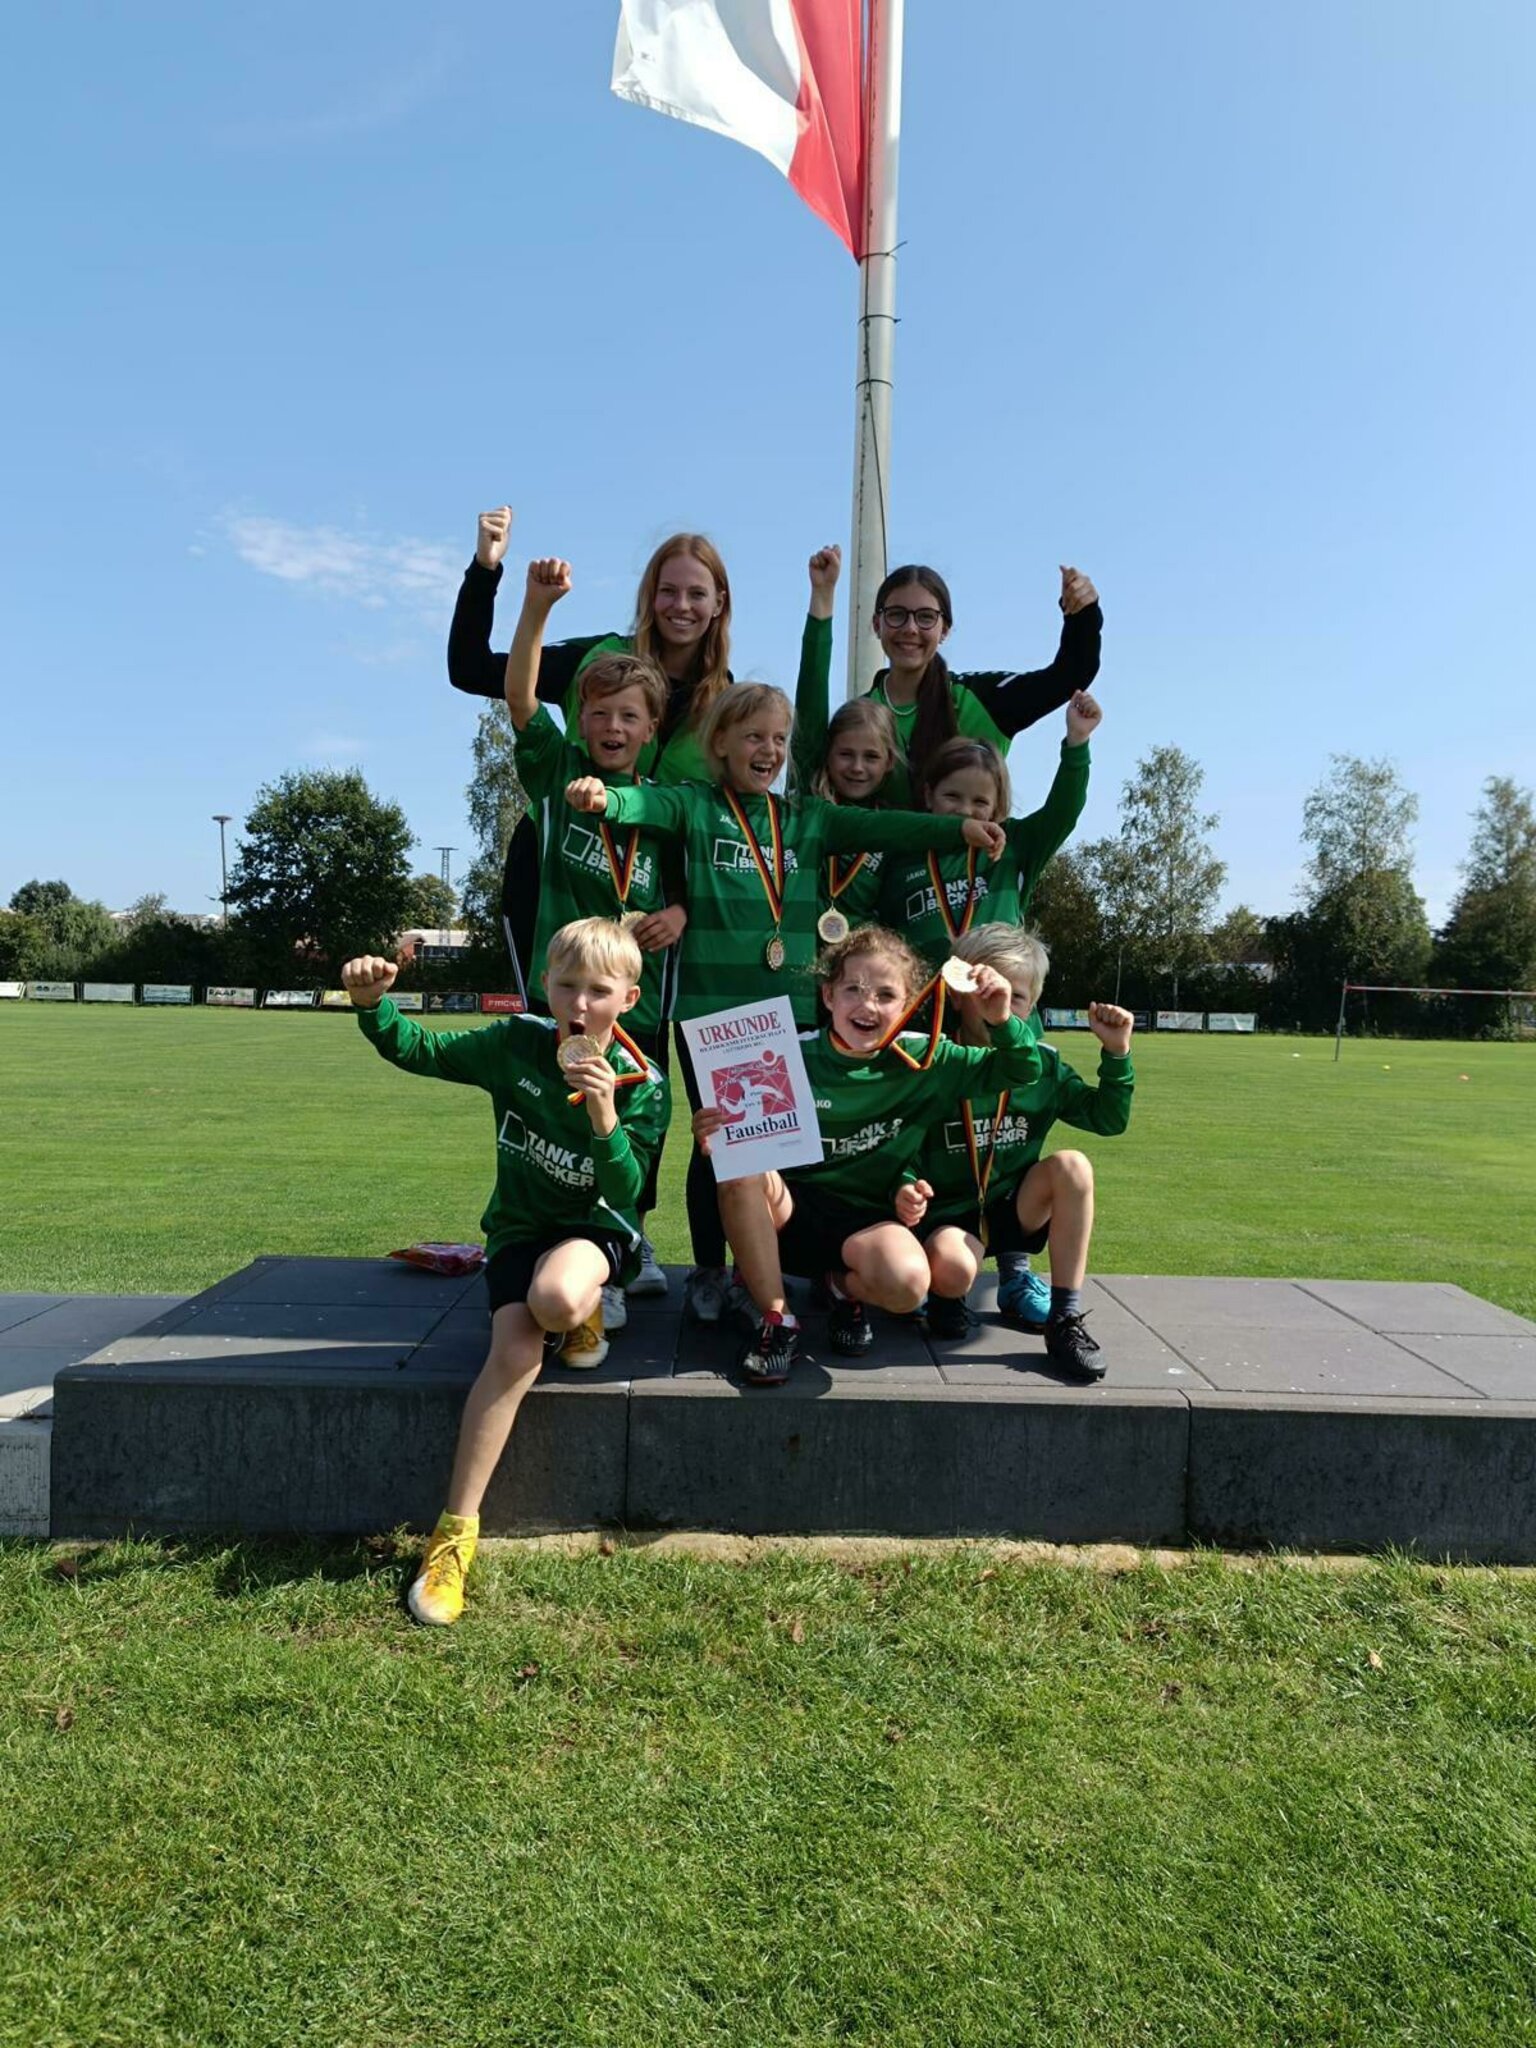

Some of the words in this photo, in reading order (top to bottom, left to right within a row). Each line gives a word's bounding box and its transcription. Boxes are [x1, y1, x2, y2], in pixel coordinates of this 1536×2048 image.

[698, 1010, 782, 1046] URKUNDE
[517, 1077, 542, 1097] JAKO
[724, 1111, 799, 1141] Faustball
[1014, 1116, 1029, 1130] &
[527, 1129, 579, 1170] TANK
[579, 1156, 595, 1175] &
